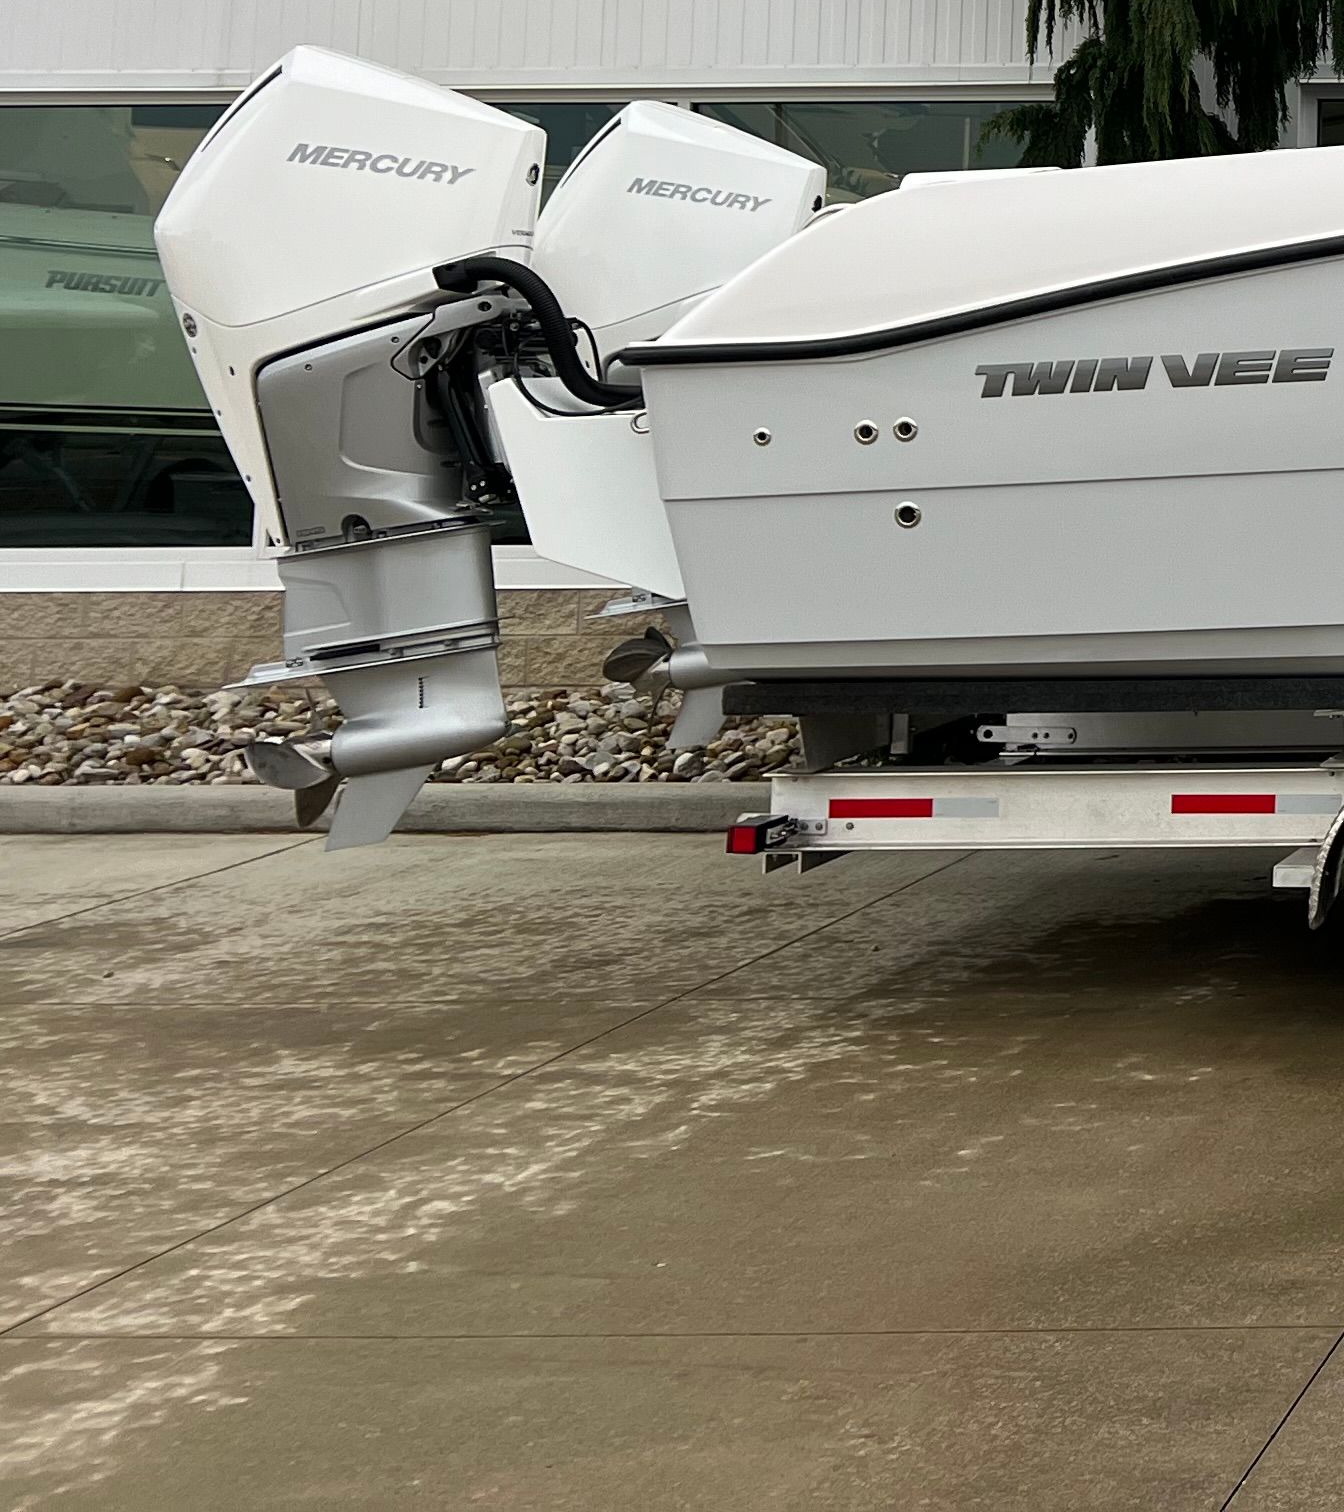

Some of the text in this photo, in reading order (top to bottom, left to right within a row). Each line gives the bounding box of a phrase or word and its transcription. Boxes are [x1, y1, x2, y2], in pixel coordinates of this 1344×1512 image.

[286, 143, 475, 185] MERCURY
[626, 177, 772, 212] MERCURY
[45, 270, 166, 297] PURSUIT
